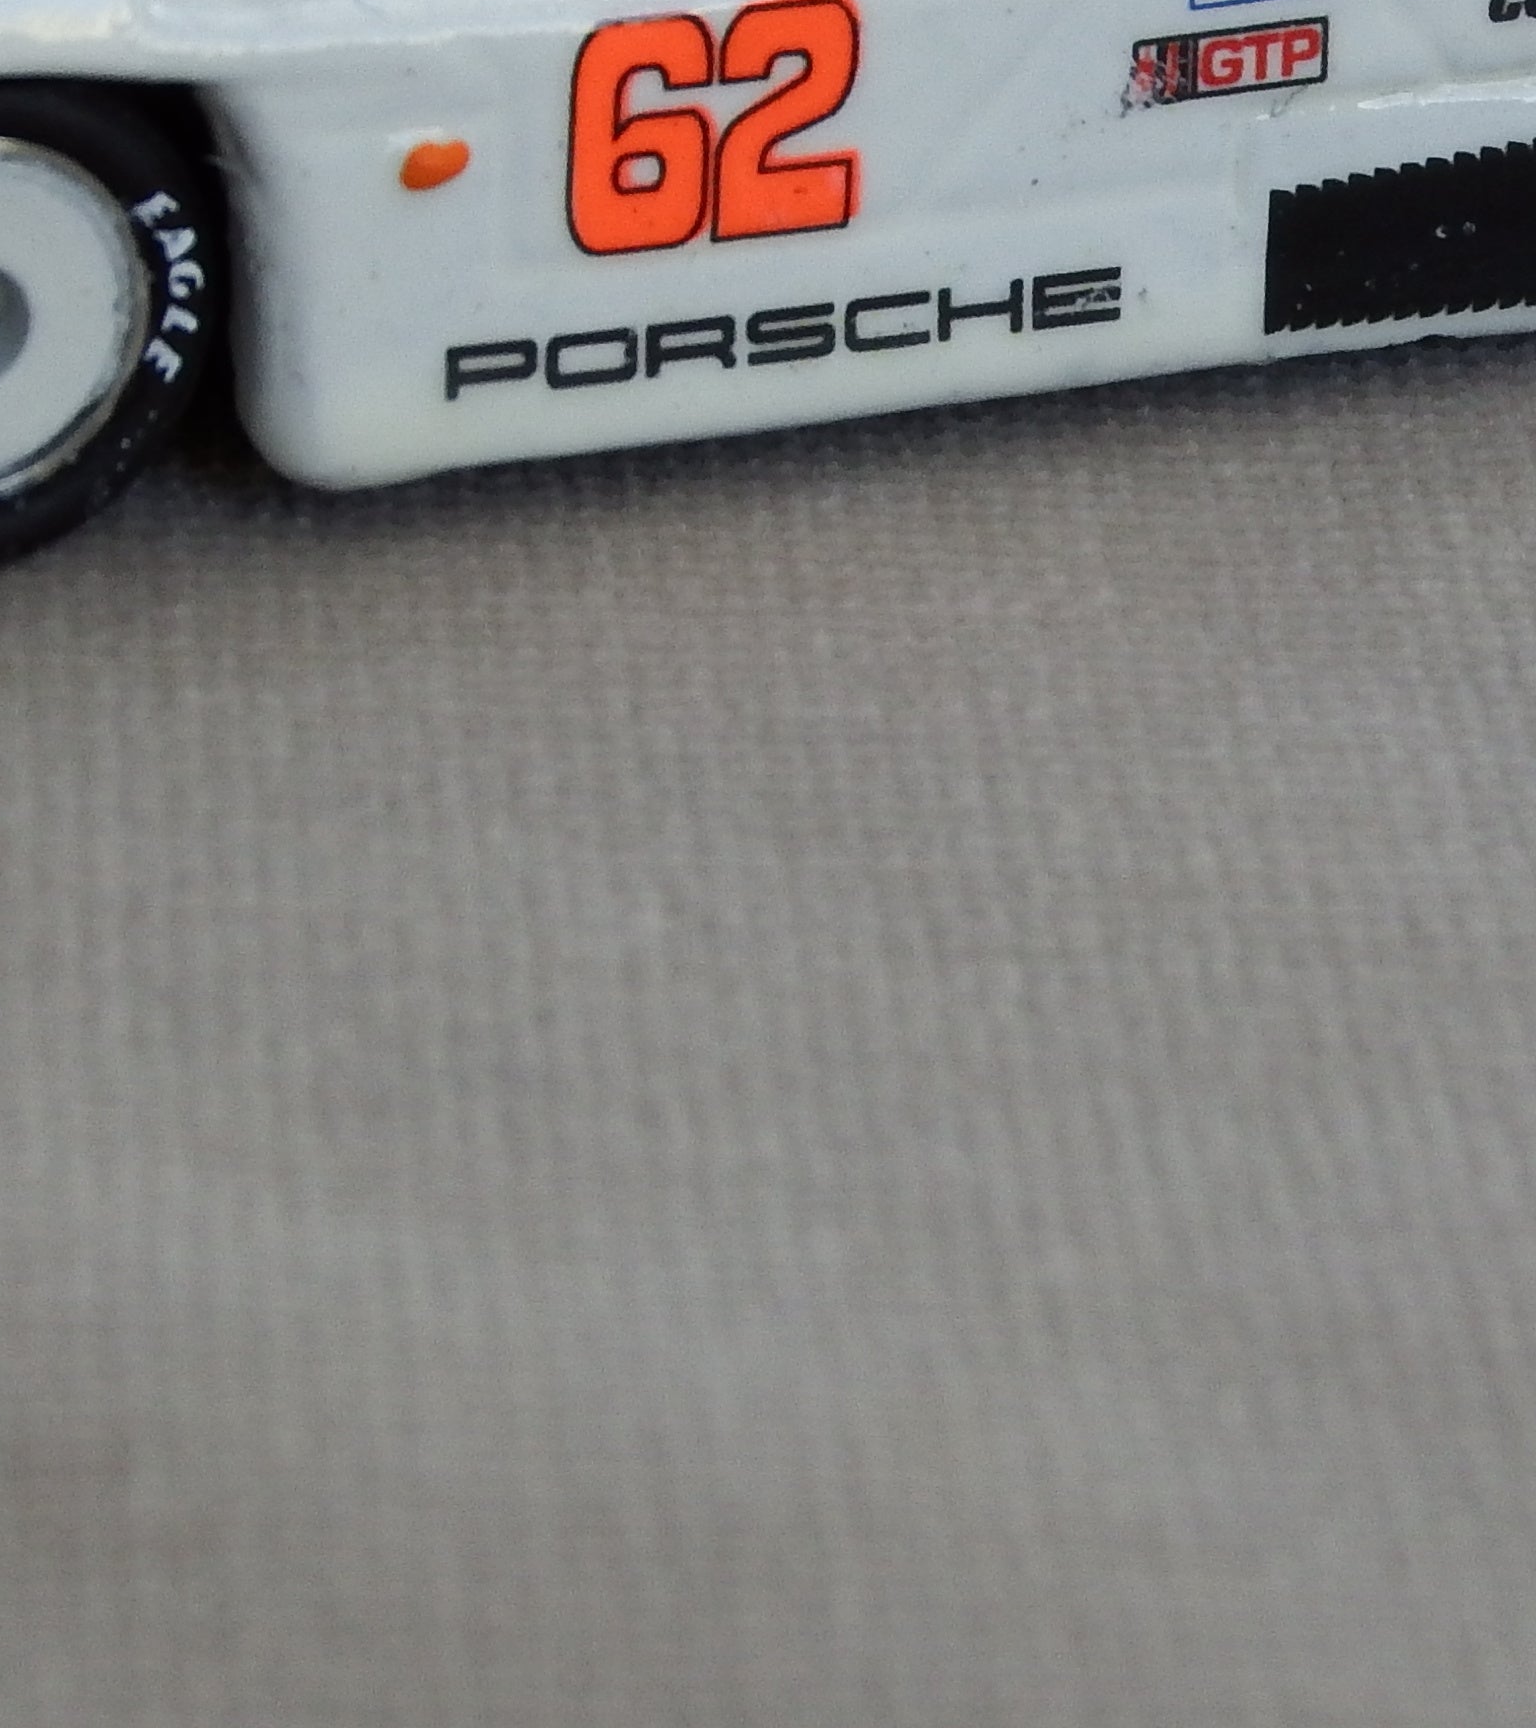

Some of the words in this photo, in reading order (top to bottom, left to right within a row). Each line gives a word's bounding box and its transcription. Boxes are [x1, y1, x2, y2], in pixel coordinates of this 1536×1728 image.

[1198, 26, 1322, 87] GTP
[130, 190, 205, 383] EAGLE
[444, 266, 1122, 402] PORSCHE
